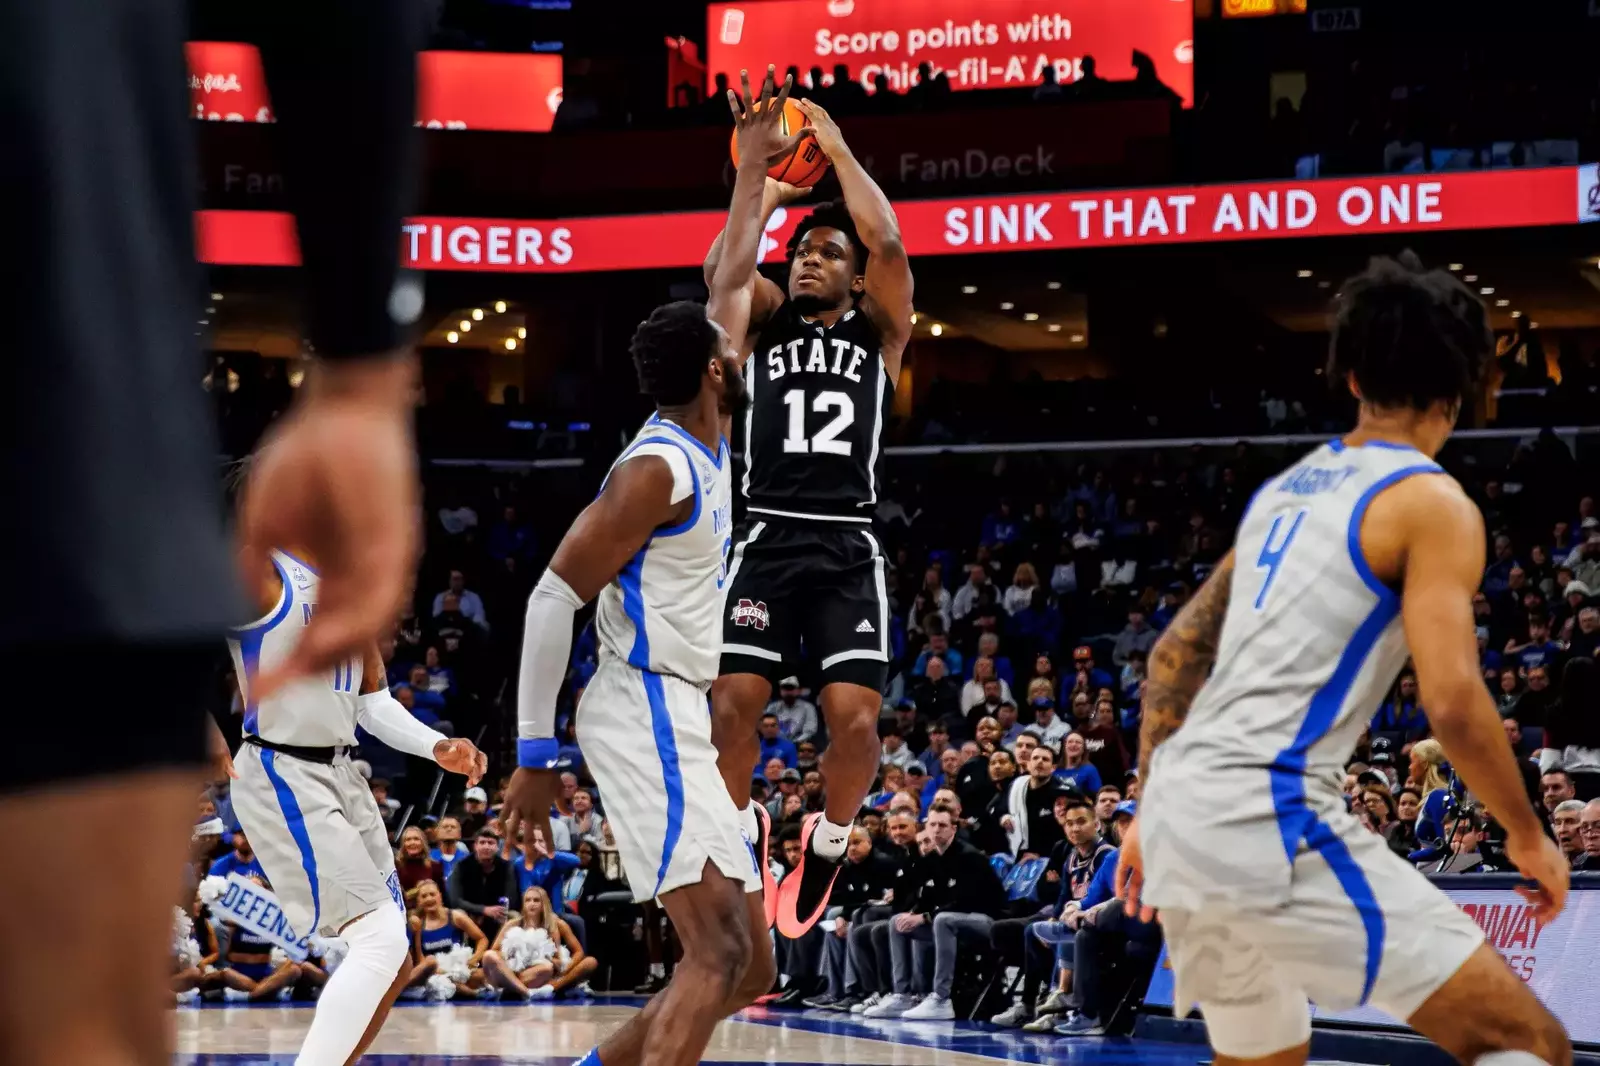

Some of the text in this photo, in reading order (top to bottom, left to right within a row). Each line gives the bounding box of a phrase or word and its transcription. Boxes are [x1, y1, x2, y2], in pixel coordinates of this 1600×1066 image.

[815, 13, 1072, 56] Score points with
[899, 144, 1054, 183] FanDeck
[944, 181, 1443, 246] SINK THAT AND ONE
[401, 223, 574, 266] TIGERS
[768, 338, 868, 383] STATE
[783, 388, 855, 457] 12
[1254, 506, 1309, 611] 4
[738, 606, 766, 622] STATE
